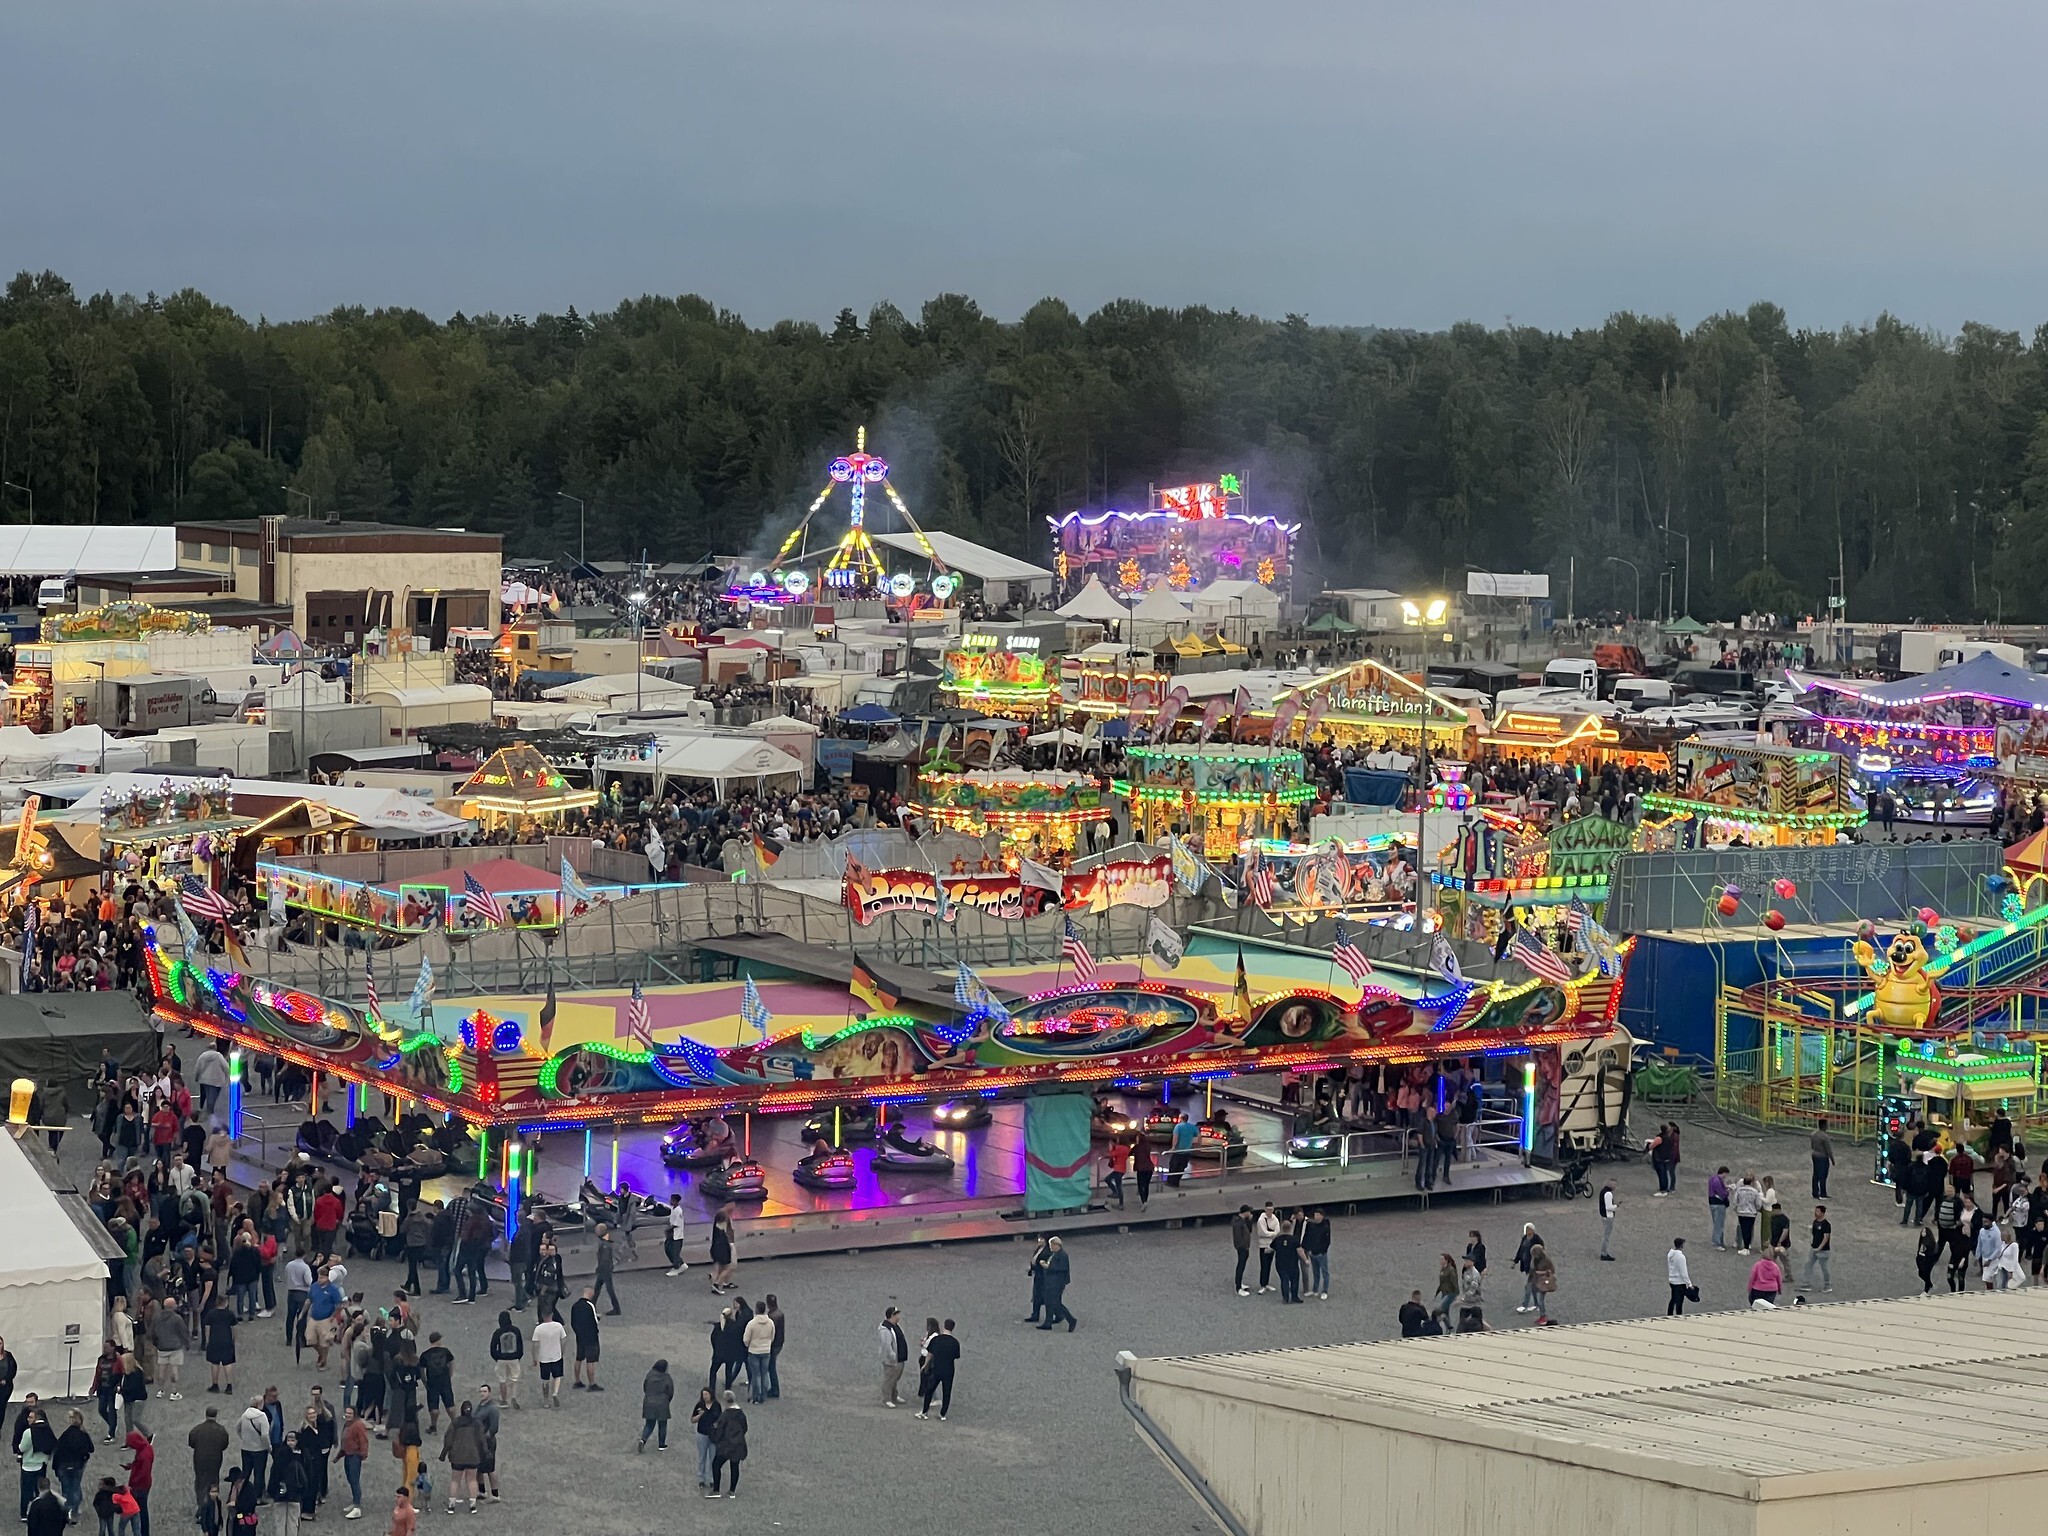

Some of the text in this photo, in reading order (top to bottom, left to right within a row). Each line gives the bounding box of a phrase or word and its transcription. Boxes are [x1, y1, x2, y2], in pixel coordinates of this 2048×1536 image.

[1163, 484, 1215, 508] BREAK
[1178, 497, 1227, 522] DANCE
[961, 634, 1040, 650] RAMBA SAMBA
